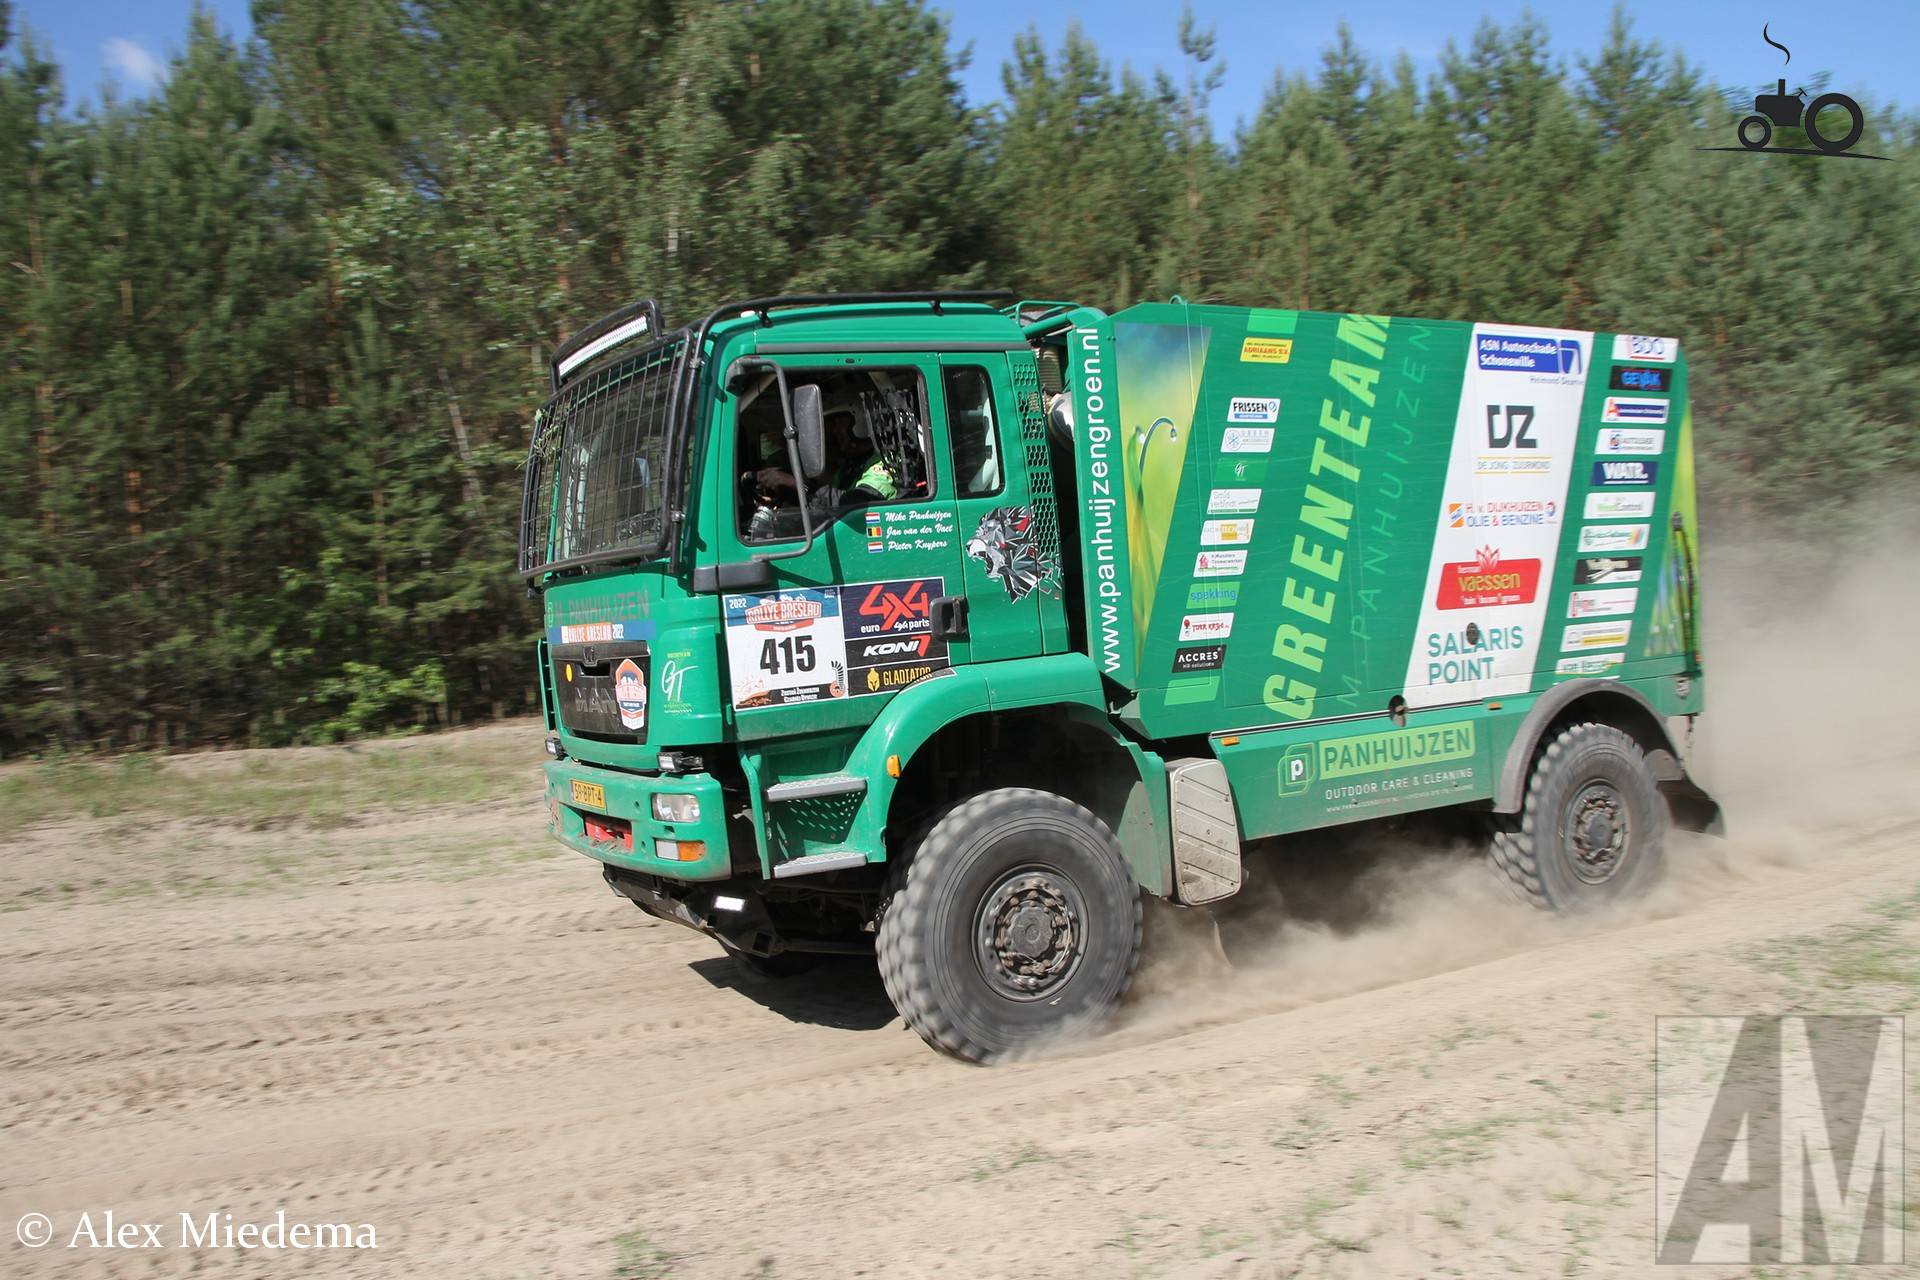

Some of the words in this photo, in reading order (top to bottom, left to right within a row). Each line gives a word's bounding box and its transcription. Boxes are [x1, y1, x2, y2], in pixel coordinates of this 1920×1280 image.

[1480, 339, 1500, 351] ASN
[1501, 340, 1558, 354] Autoschade
[1632, 336, 1665, 355] BDO
[1233, 402, 1268, 412] FRISSEN
[1350, 324, 1433, 640] PANHUIJZEN
[1076, 327, 1121, 673] www.panhuijzengroen.nl
[885, 512, 906, 522] Mike
[1263, 313, 1391, 720] GREENTEAM
[1466, 515, 1490, 527] OLIE
[1491, 515, 1499, 526] &
[1502, 514, 1544, 526] BENZINE
[886, 526, 902, 539] Jan
[920, 526, 932, 534] der
[888, 541, 912, 551] Pieter
[1458, 572, 1520, 592] vaessen
[729, 599, 747, 609] 2022
[747, 604, 779, 622] RALLYE
[781, 602, 820, 619] BRESLAU
[861, 624, 880, 634] euro
[863, 640, 920, 657] KONI
[1428, 626, 1524, 658] SALARIS
[760, 635, 816, 675] 415
[1178, 651, 1218, 663] ACCRES
[883, 666, 932, 686] GLADIATOR
[1428, 657, 1494, 686] POINT
[1325, 728, 1471, 771] PANHUIJZEN
[1325, 782, 1378, 800] OUTDOOR
[1382, 777, 1408, 791] CARE
[1412, 776, 1420, 786] &
[1423, 768, 1473, 785] CLEANING
